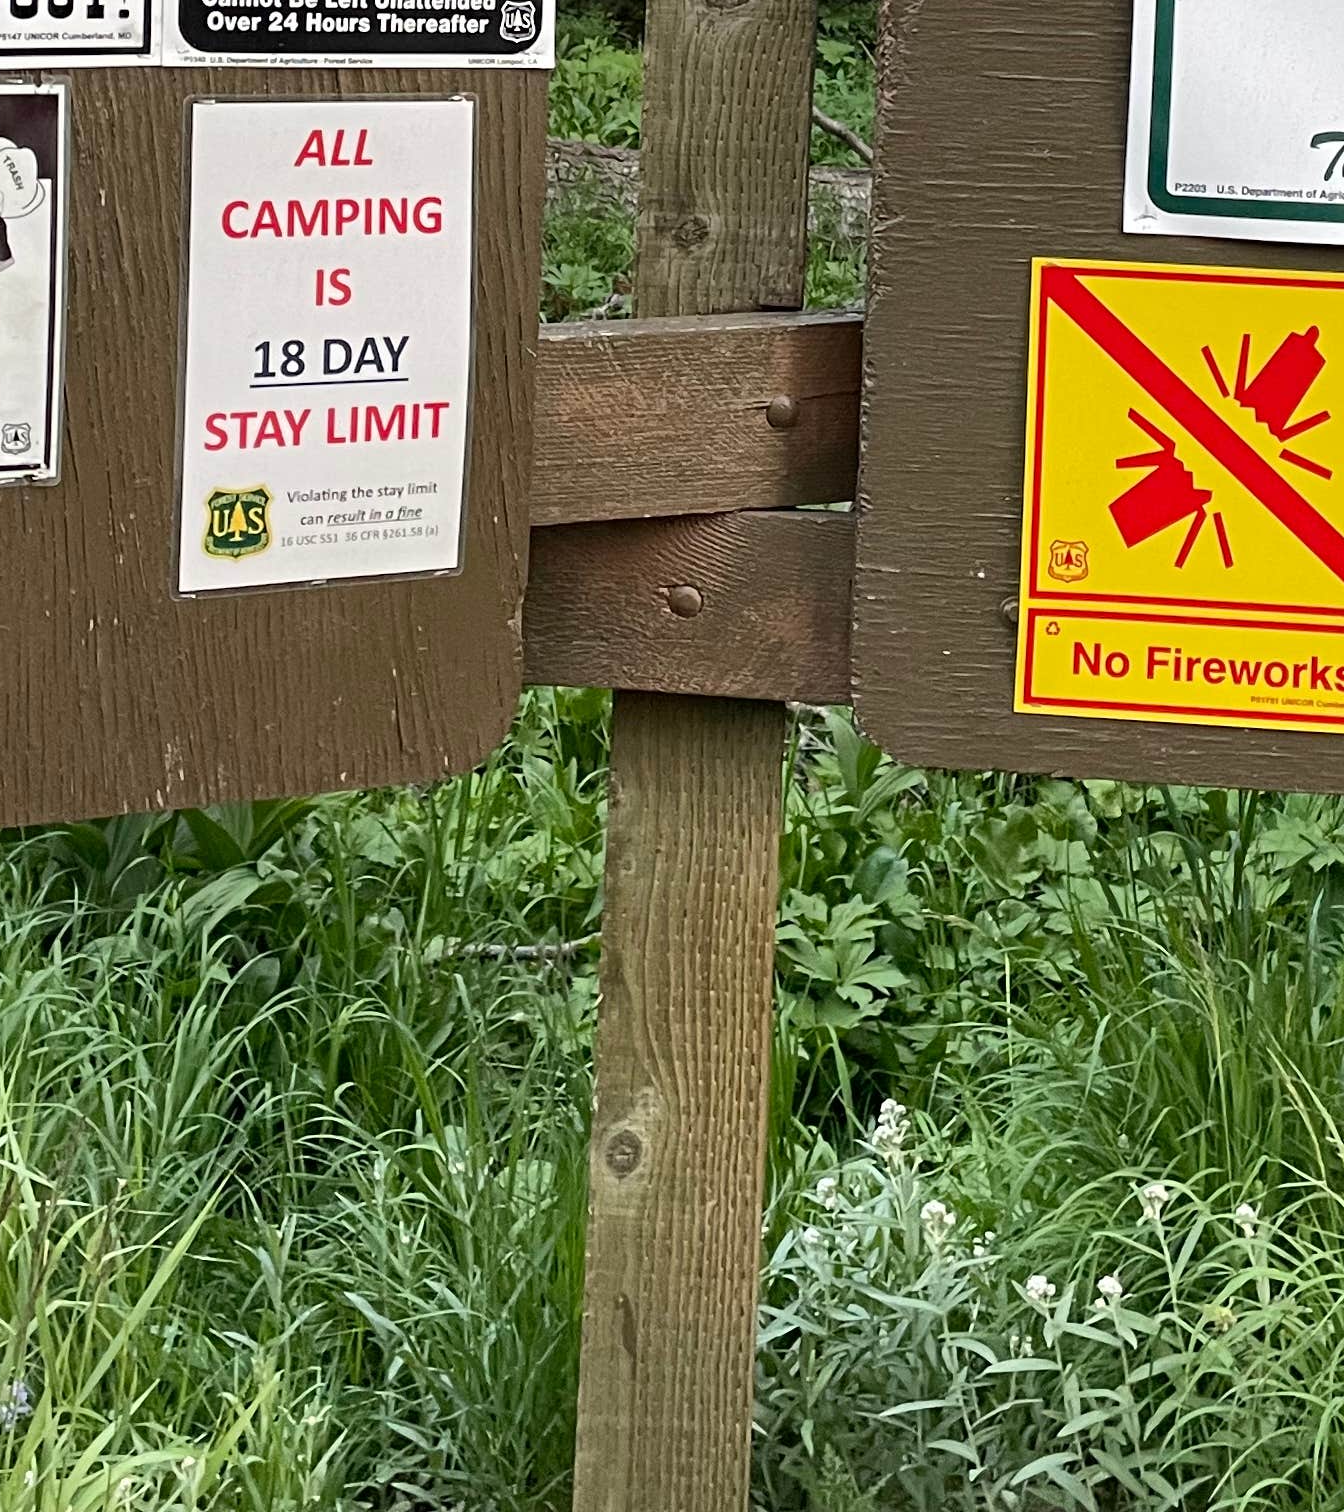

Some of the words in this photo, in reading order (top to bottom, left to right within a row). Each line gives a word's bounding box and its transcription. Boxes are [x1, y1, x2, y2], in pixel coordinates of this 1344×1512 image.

[207, 11, 261, 31] Over
[268, 12, 298, 31] 24
[306, 13, 370, 32] Hours
[377, 13, 489, 33] Thereafter
[294, 129, 372, 167] ALL
[3, 156, 24, 190] TRASH
[222, 197, 441, 238] CAMPING
[316, 268, 351, 306] IS
[254, 340, 305, 377] 18
[324, 336, 409, 374] DAY
[205, 409, 311, 451] STAY
[327, 402, 449, 443] LIMIT
[287, 489, 347, 503] Violating
[352, 487, 373, 498] the
[378, 487, 404, 498] stay
[408, 483, 437, 494] limit
[301, 516, 323, 525] can
[327, 510, 365, 526] result
[369, 509, 381, 520] in
[396, 506, 422, 522] fine
[1073, 642, 1129, 678] No
